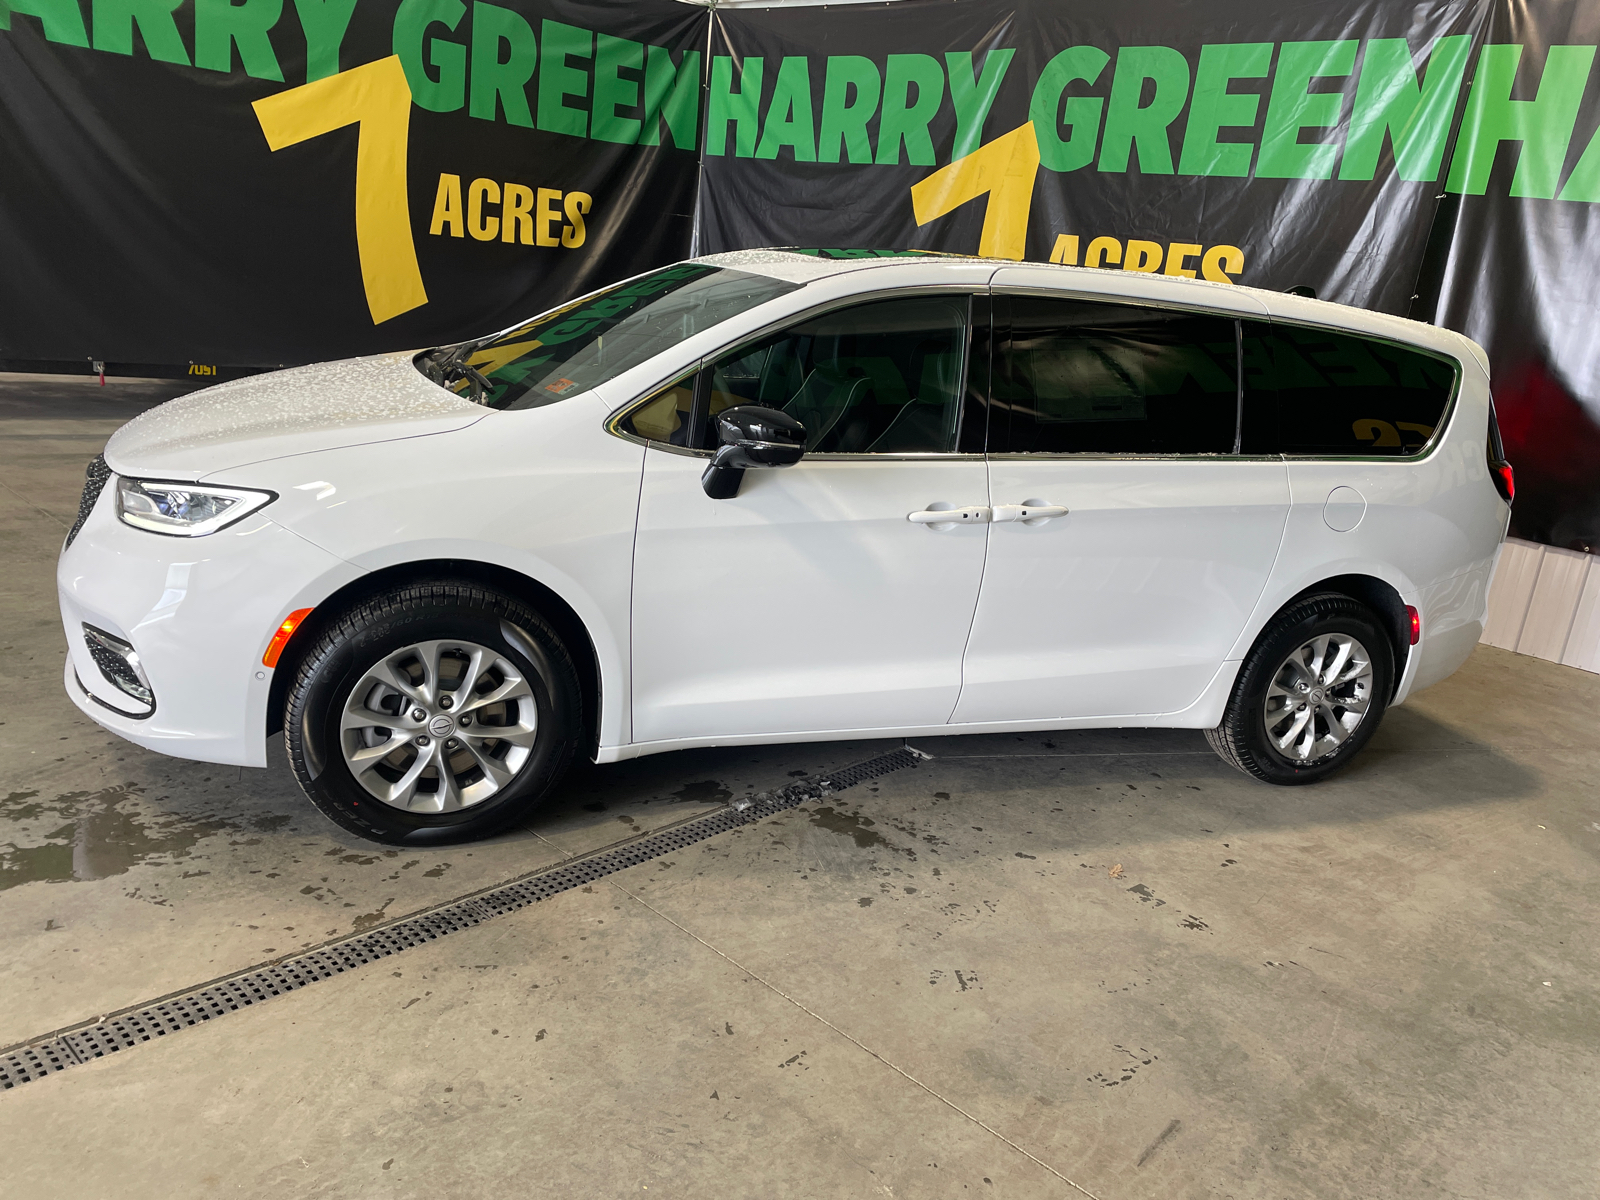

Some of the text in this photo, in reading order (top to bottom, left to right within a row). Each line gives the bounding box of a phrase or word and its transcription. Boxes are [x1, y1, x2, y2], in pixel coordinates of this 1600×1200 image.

[392, 0, 700, 151] GREEN
[706, 34, 1472, 182] HARRY GREEN
[1445, 44, 1600, 203] H
[251, 54, 593, 325] 7 ACRES
